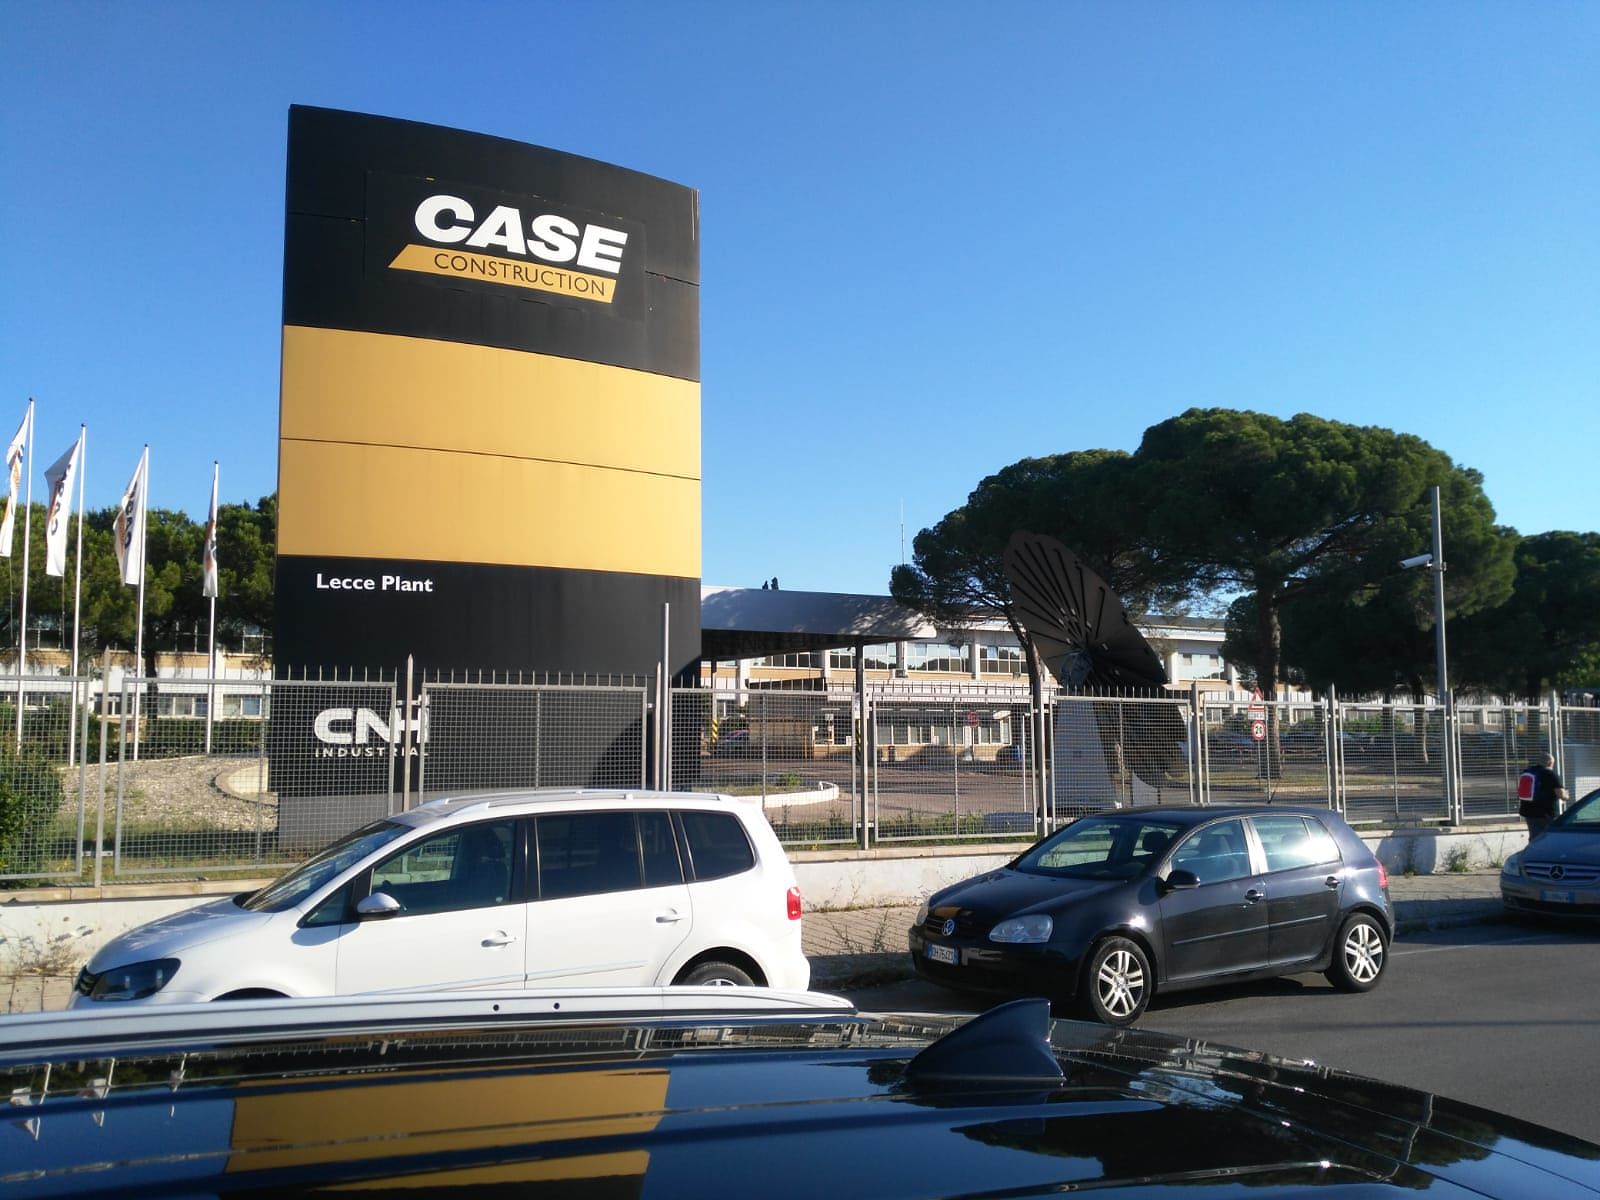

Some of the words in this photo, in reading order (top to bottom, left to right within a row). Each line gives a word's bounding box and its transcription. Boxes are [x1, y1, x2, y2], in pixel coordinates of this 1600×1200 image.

[414, 194, 629, 274] CASE
[434, 252, 605, 297] CONSTRUCTION
[316, 573, 375, 590] Lecce
[381, 575, 433, 592] Plant
[314, 707, 430, 744] CNH
